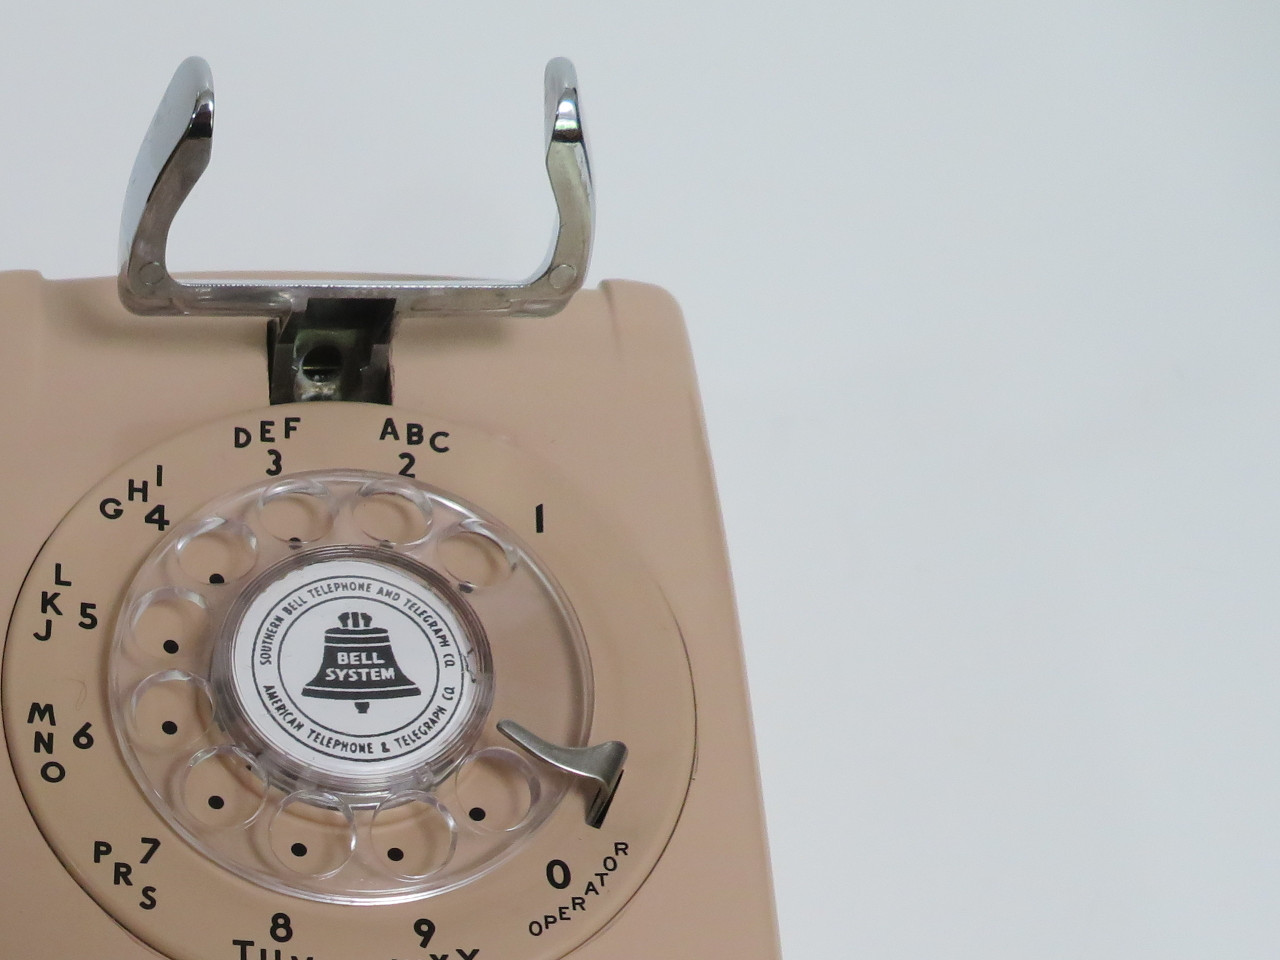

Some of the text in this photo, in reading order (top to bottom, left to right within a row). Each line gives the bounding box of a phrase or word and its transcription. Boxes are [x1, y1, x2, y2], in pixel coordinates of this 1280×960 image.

[234, 417, 302, 449] DEF
[379, 417, 450, 453] ABC
[265, 448, 283, 477] 3
[398, 452, 416, 479] 2
[144, 504, 170, 532] 4
[78, 602, 98, 630] 5
[260, 615, 285, 666] SOUTHERN
[282, 596, 308, 616] BELL
[307, 582, 373, 599] TELEPHONE
[376, 586, 401, 602] AND
[403, 598, 451, 648] TELEGRAPH
[337, 652, 386, 665] BELL
[325, 667, 396, 682] SYSTEM
[262, 685, 305, 732] AMERICAN
[307, 731, 374, 755] TELEPHONE
[380, 742, 391, 754] &
[393, 705, 448, 749] TELEGRAPH
[72, 721, 94, 750] 6
[139, 837, 161, 864] 7
[528, 841, 629, 937] OPERATOR
[269, 912, 294, 943] 8
[413, 918, 436, 949] 9
